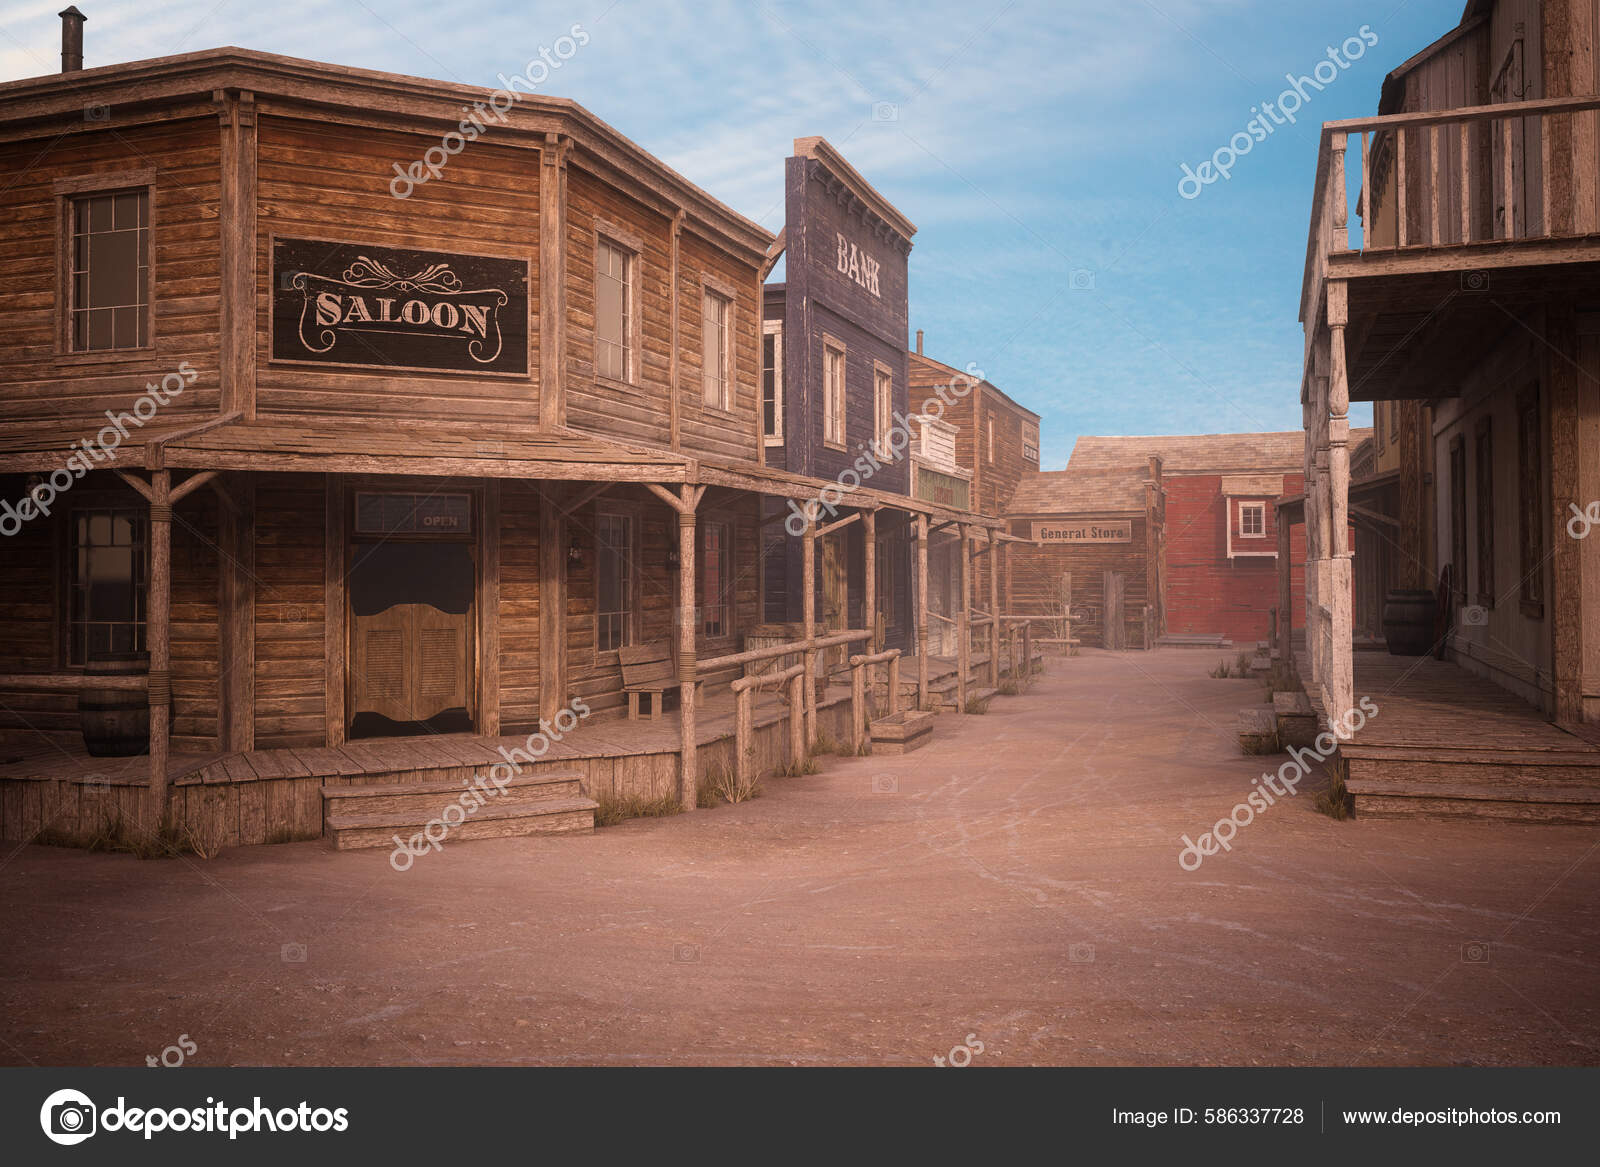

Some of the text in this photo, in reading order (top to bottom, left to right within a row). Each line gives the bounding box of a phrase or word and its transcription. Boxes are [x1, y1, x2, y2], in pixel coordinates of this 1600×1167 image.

[836, 231, 881, 299] BANK
[316, 292, 491, 339] SALOON
[423, 515, 458, 527] OPEN
[1040, 526, 1124, 539] General Store
